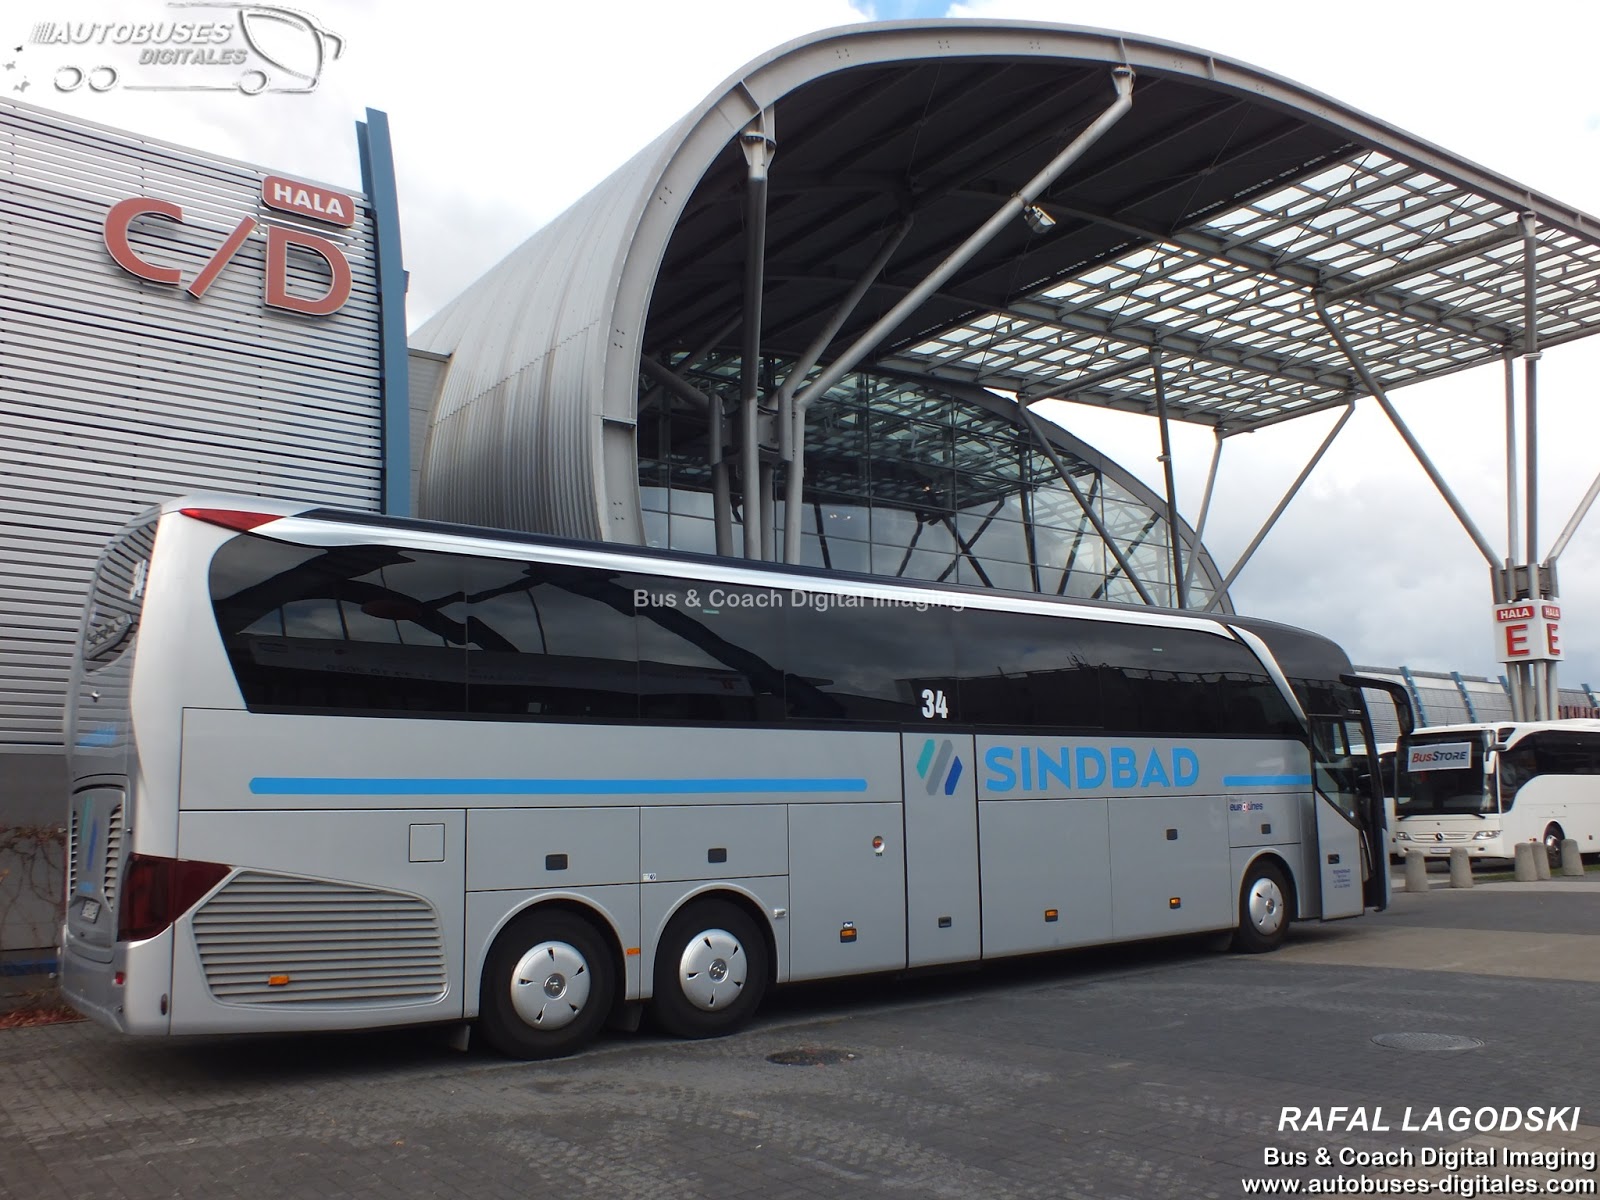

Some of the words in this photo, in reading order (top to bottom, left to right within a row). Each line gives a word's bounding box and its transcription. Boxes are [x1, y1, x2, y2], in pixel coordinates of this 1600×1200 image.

[273, 182, 346, 219] HALA
[103, 196, 354, 316] C/D
[1500, 607, 1530, 620] HALA
[1545, 606, 1560, 617] HALA
[1505, 624, 1531, 657] E
[1546, 623, 1561, 655] E
[921, 688, 949, 719] 34
[984, 745, 1200, 792] SINDBAD
